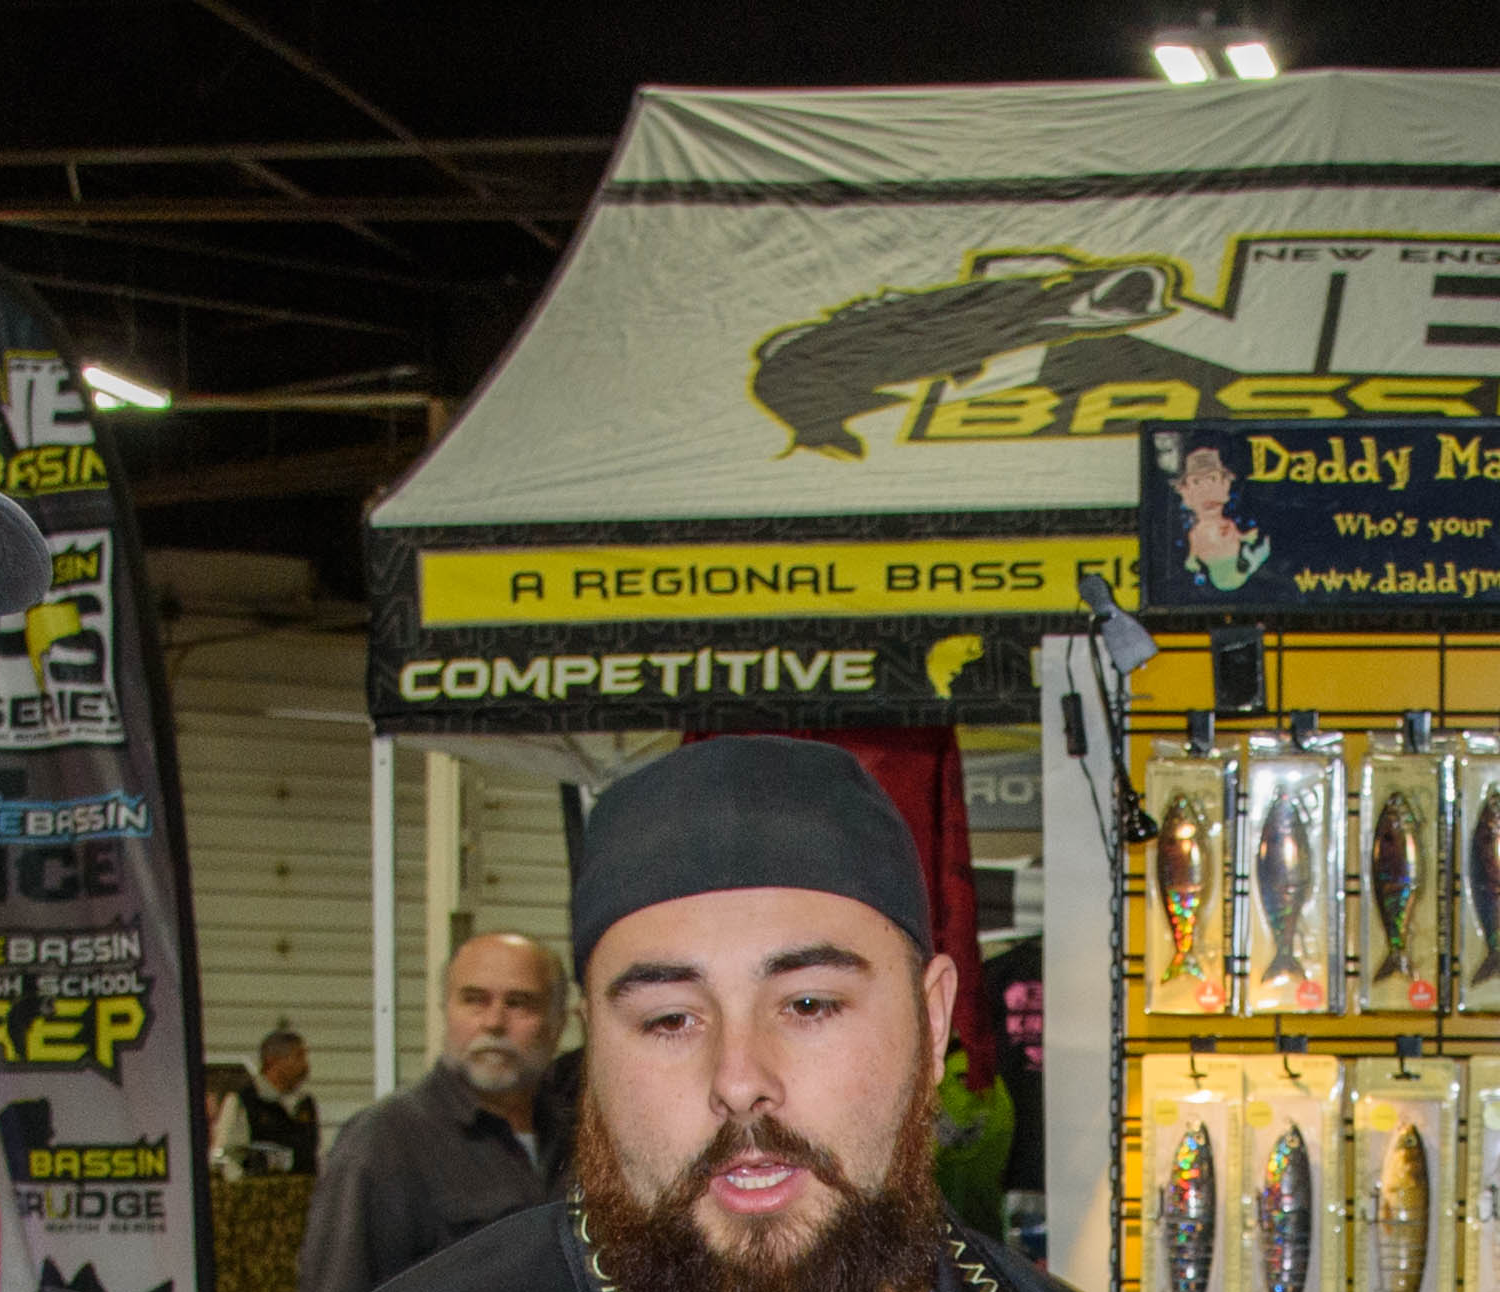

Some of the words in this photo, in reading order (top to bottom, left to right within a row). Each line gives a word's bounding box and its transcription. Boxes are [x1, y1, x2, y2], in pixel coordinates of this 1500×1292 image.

[1250, 246, 1374, 265] NEW
[1246, 434, 1414, 490] Daddy
[1333, 511, 1418, 539] Who's
[1428, 514, 1492, 544] your
[510, 571, 545, 603] A
[573, 562, 856, 600] REGIONAL
[887, 562, 1045, 593] BASS
[400, 647, 879, 701] COMPETITIVE
[37, 971, 145, 998] SCHOOL
